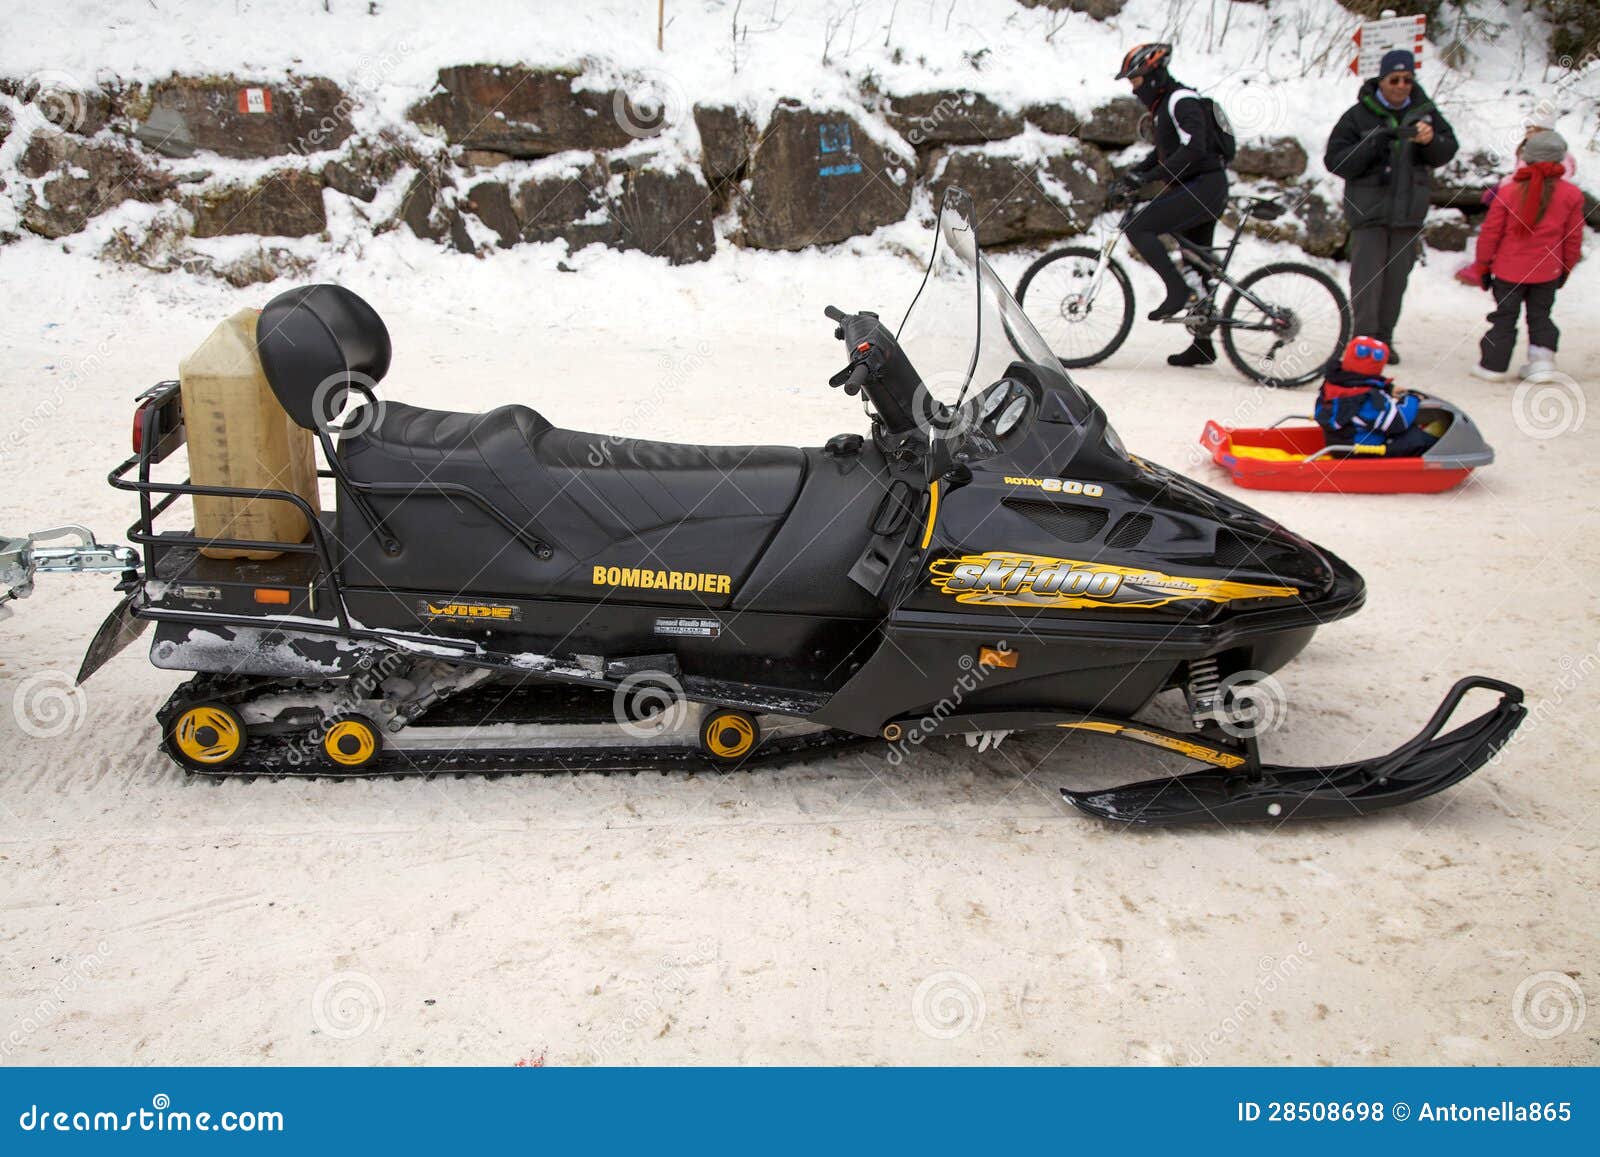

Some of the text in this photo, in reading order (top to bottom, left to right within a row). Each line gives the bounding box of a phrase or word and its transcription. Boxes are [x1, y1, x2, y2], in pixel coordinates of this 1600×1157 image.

[1003, 477, 1042, 487] ROTAX
[592, 565, 732, 594] BOMBARDIER
[427, 604, 513, 619] WIDE
